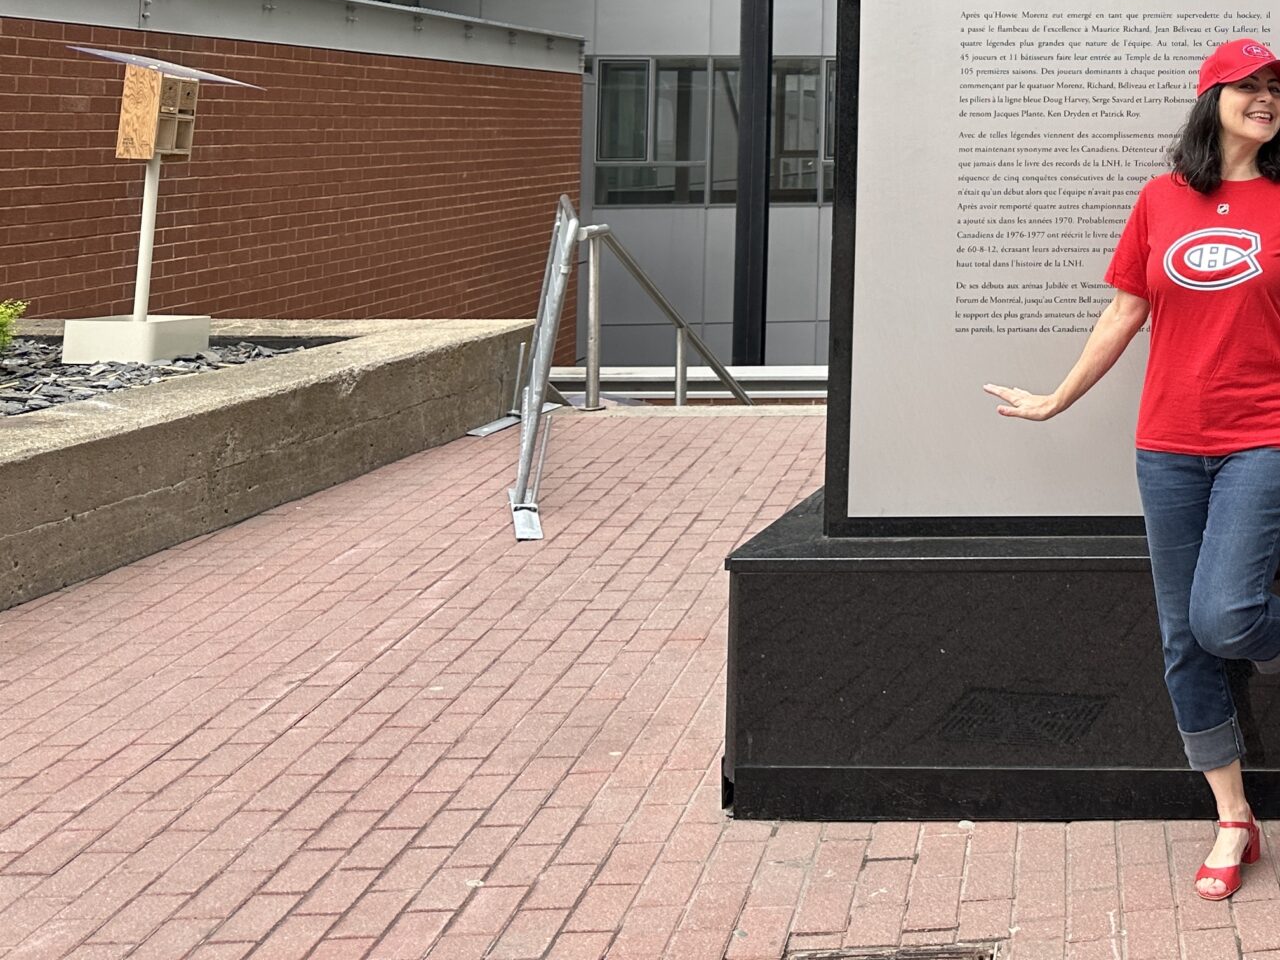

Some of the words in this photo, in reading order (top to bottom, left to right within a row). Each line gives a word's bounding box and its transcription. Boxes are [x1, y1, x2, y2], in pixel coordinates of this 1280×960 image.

[1056, 68, 1083, 77] joueurs
[1084, 67, 1122, 75] dominants
[1130, 67, 1155, 77] chaque
[1157, 68, 1186, 77] position
[993, 110, 1020, 119] Jacques
[1063, 109, 1090, 119] Dryden
[1126, 110, 1141, 119] Roy.
[957, 203, 978, 212] Après
[999, 202, 1032, 212] remporté
[1033, 202, 1057, 212] quatre
[1081, 202, 1131, 212] championnats
[1006, 231, 1046, 239] 1976-1977
[974, 259, 991, 267] total
[1011, 259, 1043, 267] l'histoire
[1043, 259, 1053, 267] de
[1054, 259, 1061, 267] la
[1007, 325, 1038, 335] partisans
